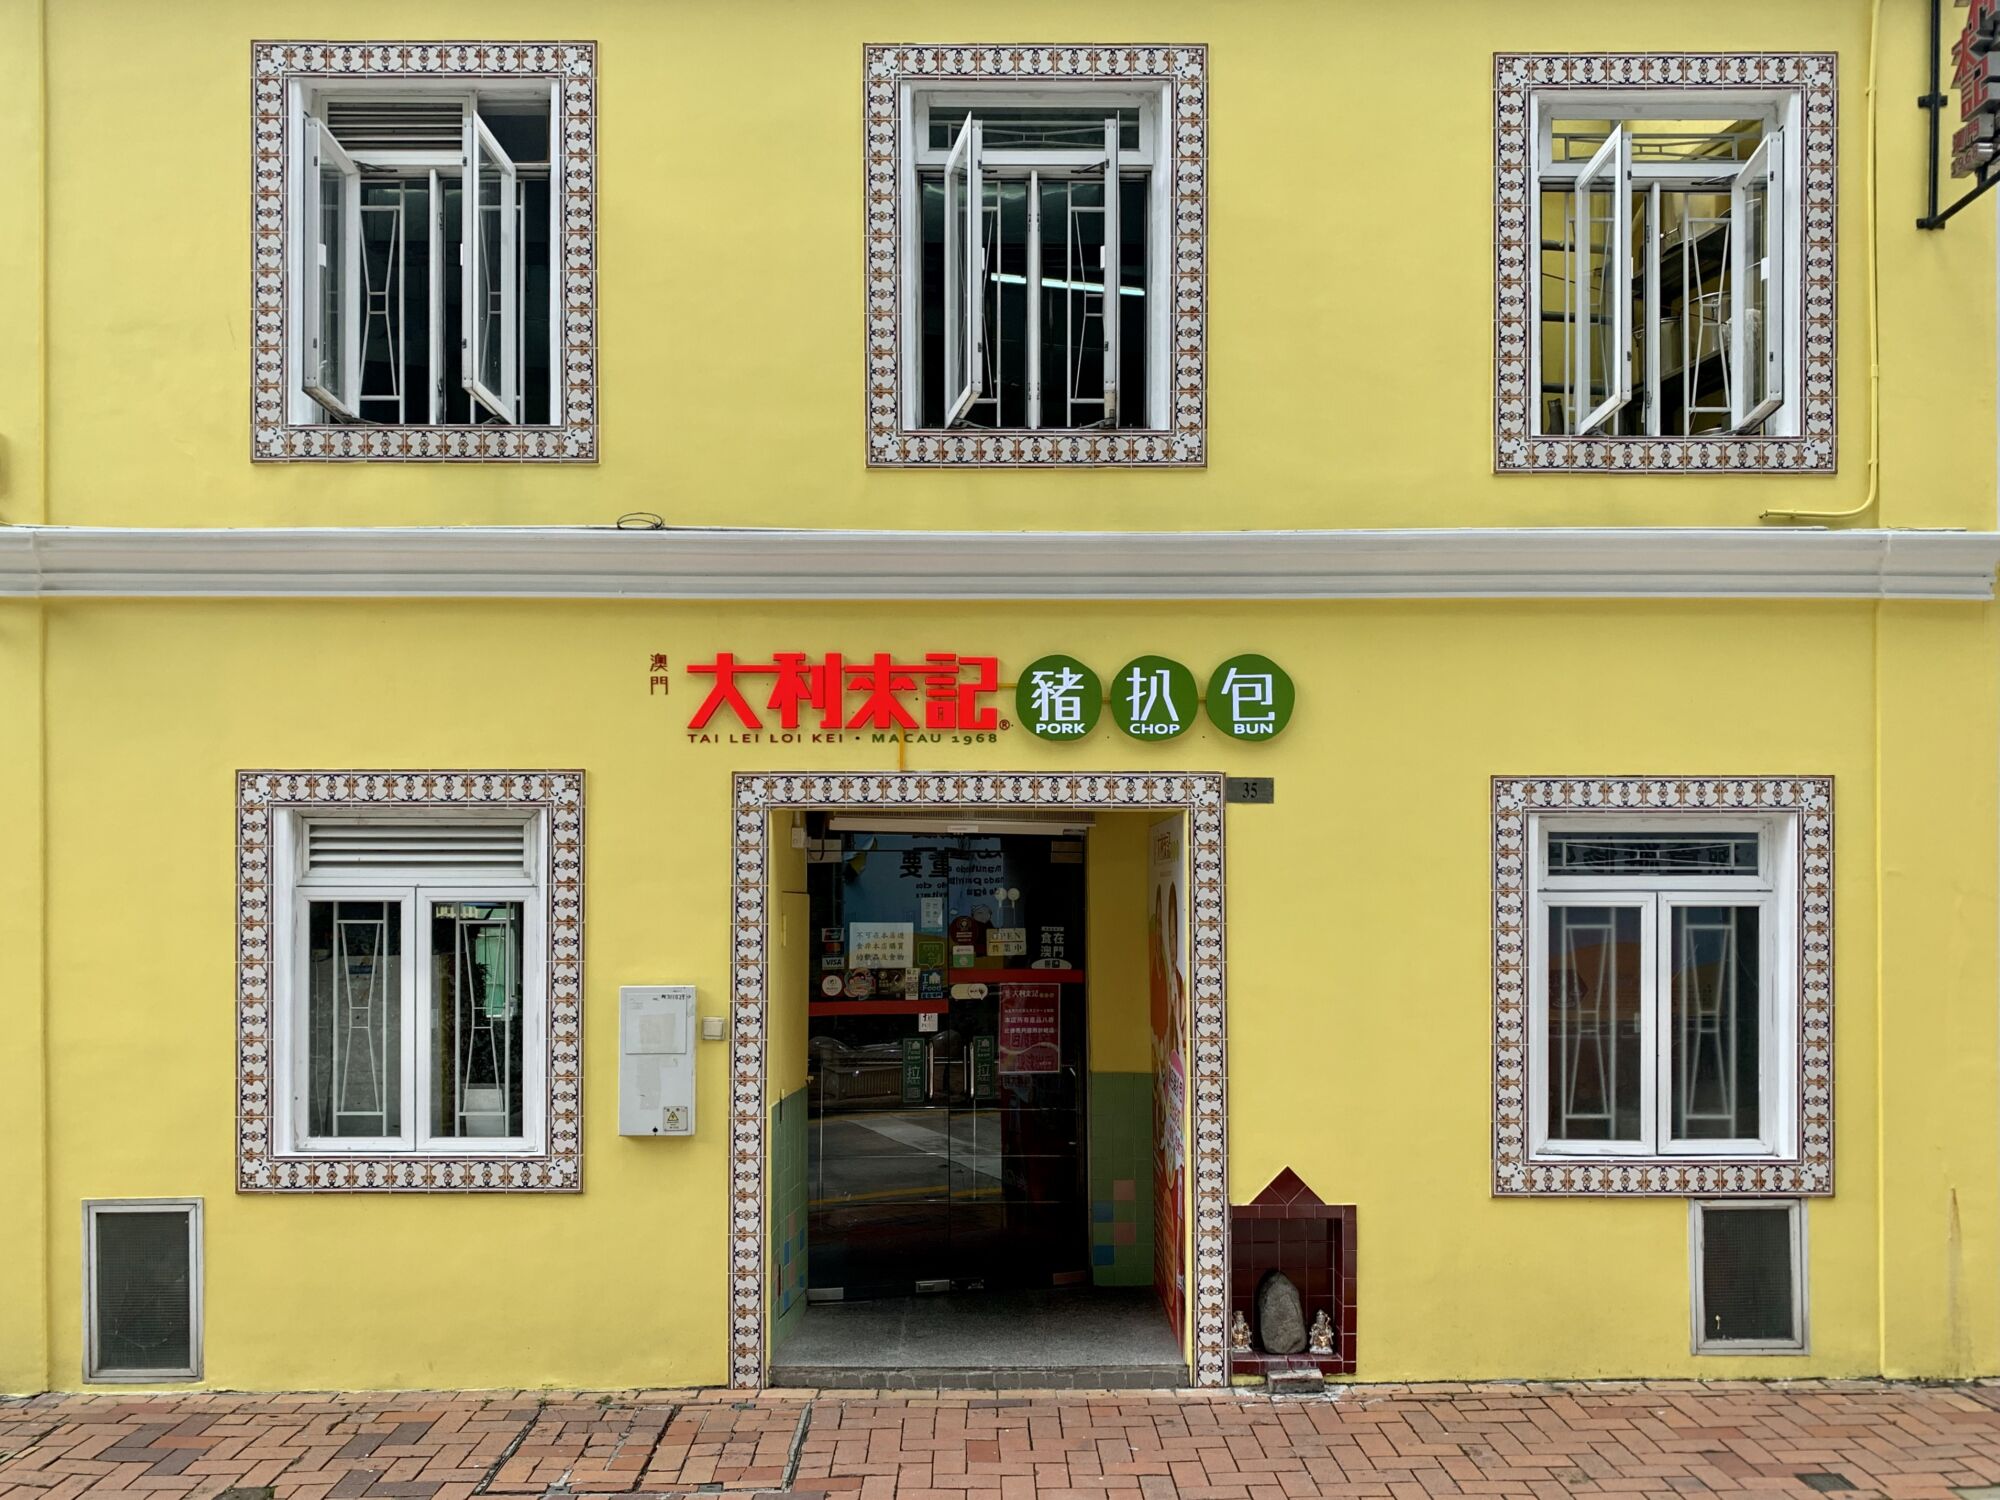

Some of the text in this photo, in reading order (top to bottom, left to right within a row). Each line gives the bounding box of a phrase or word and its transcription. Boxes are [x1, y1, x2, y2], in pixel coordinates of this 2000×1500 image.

[650, 653, 669, 696] 澳門
[1035, 722, 1274, 735] PORK CHOP BUN
[687, 733, 998, 746] TAI LEI LOI KEI MACAU 1968
[1242, 782, 1258, 799] 35
[991, 932, 1022, 941] OPEN
[1040, 946, 1065, 958] 澳門
